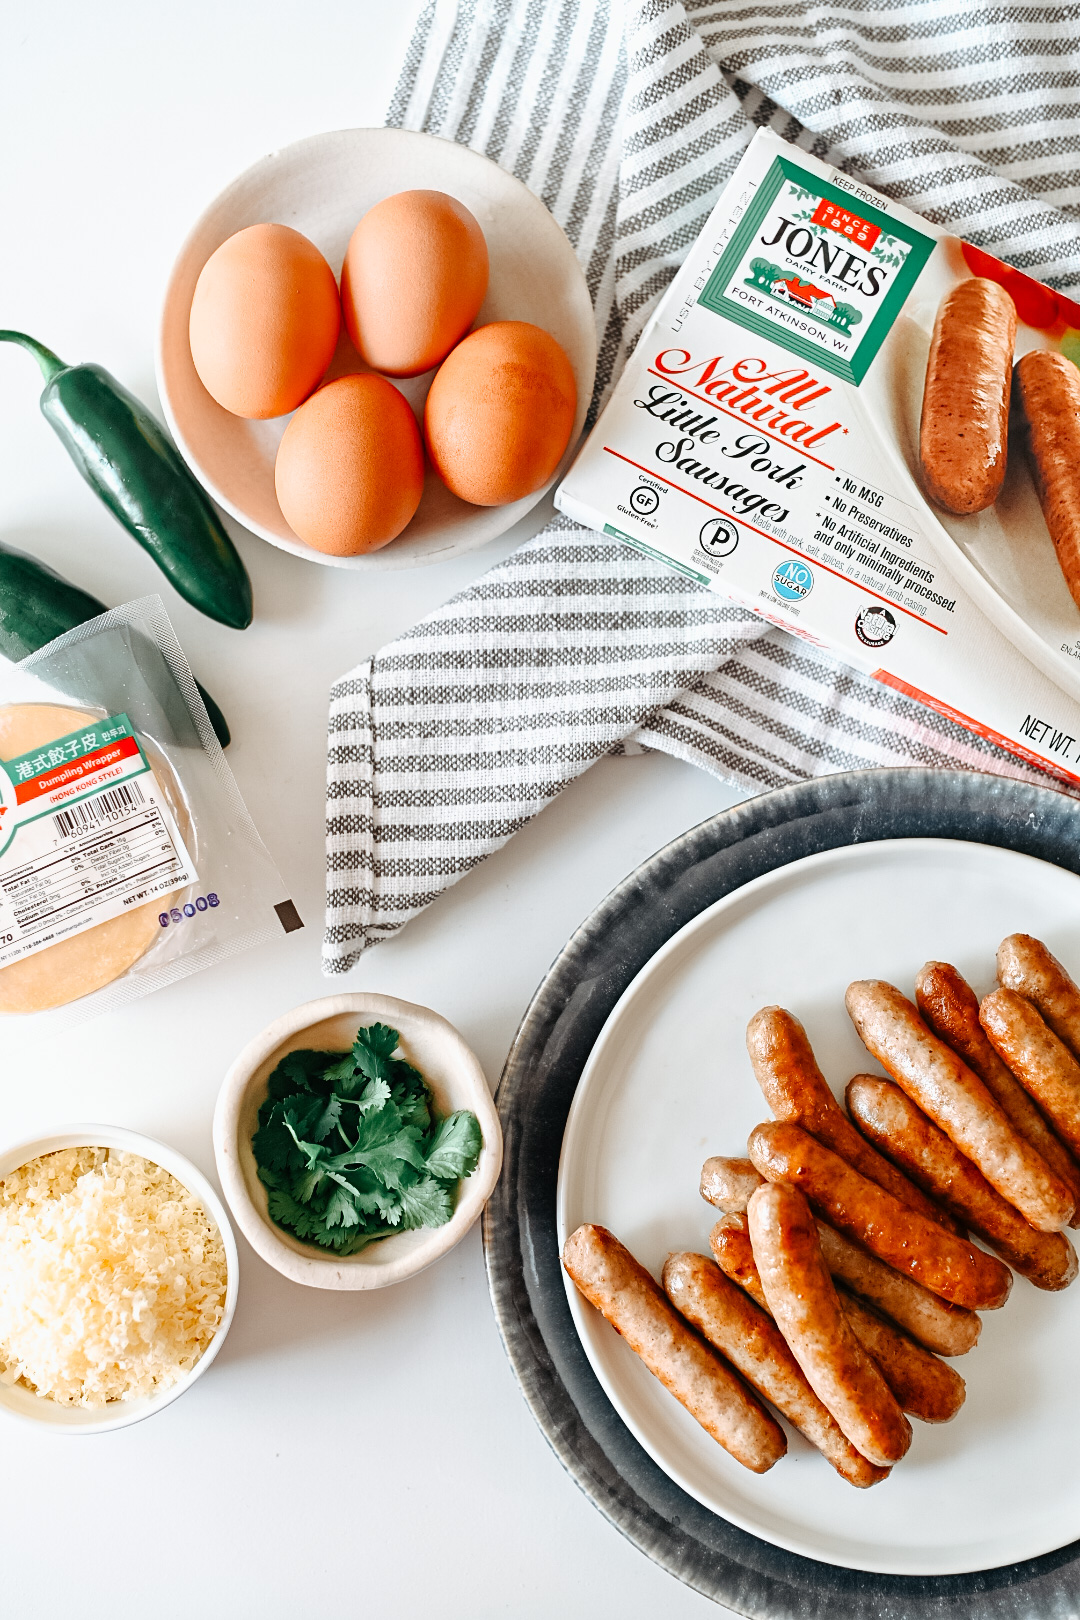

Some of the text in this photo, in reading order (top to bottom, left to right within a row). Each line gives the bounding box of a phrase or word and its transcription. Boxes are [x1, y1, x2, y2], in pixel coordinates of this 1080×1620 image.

[832, 175, 888, 210] KEEP FROZEN
[822, 214, 867, 241] 1889
[825, 206, 870, 233] SINCE
[761, 217, 888, 296] JONES
[785, 257, 847, 292] DAIRY FARM
[671, 295, 696, 332] USE
[694, 260, 712, 290] BY
[732, 287, 848, 353] FORT ATKINSON, WI
[732, 358, 831, 411] All
[634, 385, 806, 491] Little Pork
[638, 475, 668, 494] Certified
[656, 438, 790, 523] Sausages
[842, 478, 884, 508] No MSG
[636, 494, 654, 506] GF
[712, 520, 736, 536] CERTIFIED
[832, 496, 914, 548] No Preservatives
[710, 526, 730, 546] P
[822, 516, 936, 584] No Artificial Ingredients
[751, 514, 928, 616] Made with pork, salt, spices, in a natural lamb casing.
[784, 563, 808, 584] NO
[814, 529, 956, 613] and only minimally processed.
[774, 574, 808, 596] SUGAR
[856, 605, 900, 636] Natural
[101, 725, 127, 741] 만두피
[1019, 714, 1052, 744] NET
[1049, 730, 1076, 758] WT.
[15, 733, 100, 781] 港式餃子皮
[38, 749, 121, 790] Dumpling Wrapper
[50, 767, 123, 803] (HONG KONG STYLE)
[70, 820, 102, 838] 60941
[106, 805, 137, 822] 10154
[82, 848, 99, 857] Total
[100, 842, 115, 850] Carb.
[90, 854, 108, 864] Dietary
[108, 848, 121, 856] Fiber
[92, 862, 106, 871] Total
[106, 854, 125, 866] Sugars
[116, 860, 133, 870] Added
[133, 854, 150, 863] Sugars
[4, 884, 19, 893] Total
[11, 886, 35, 899] Saturated
[95, 877, 118, 888] Protein
[13, 897, 28, 906] Trans
[13, 898, 48, 916] Cholesterol
[123, 895, 136, 905] NET
[136, 890, 149, 899] WT.
[16, 912, 39, 924] Sodium
